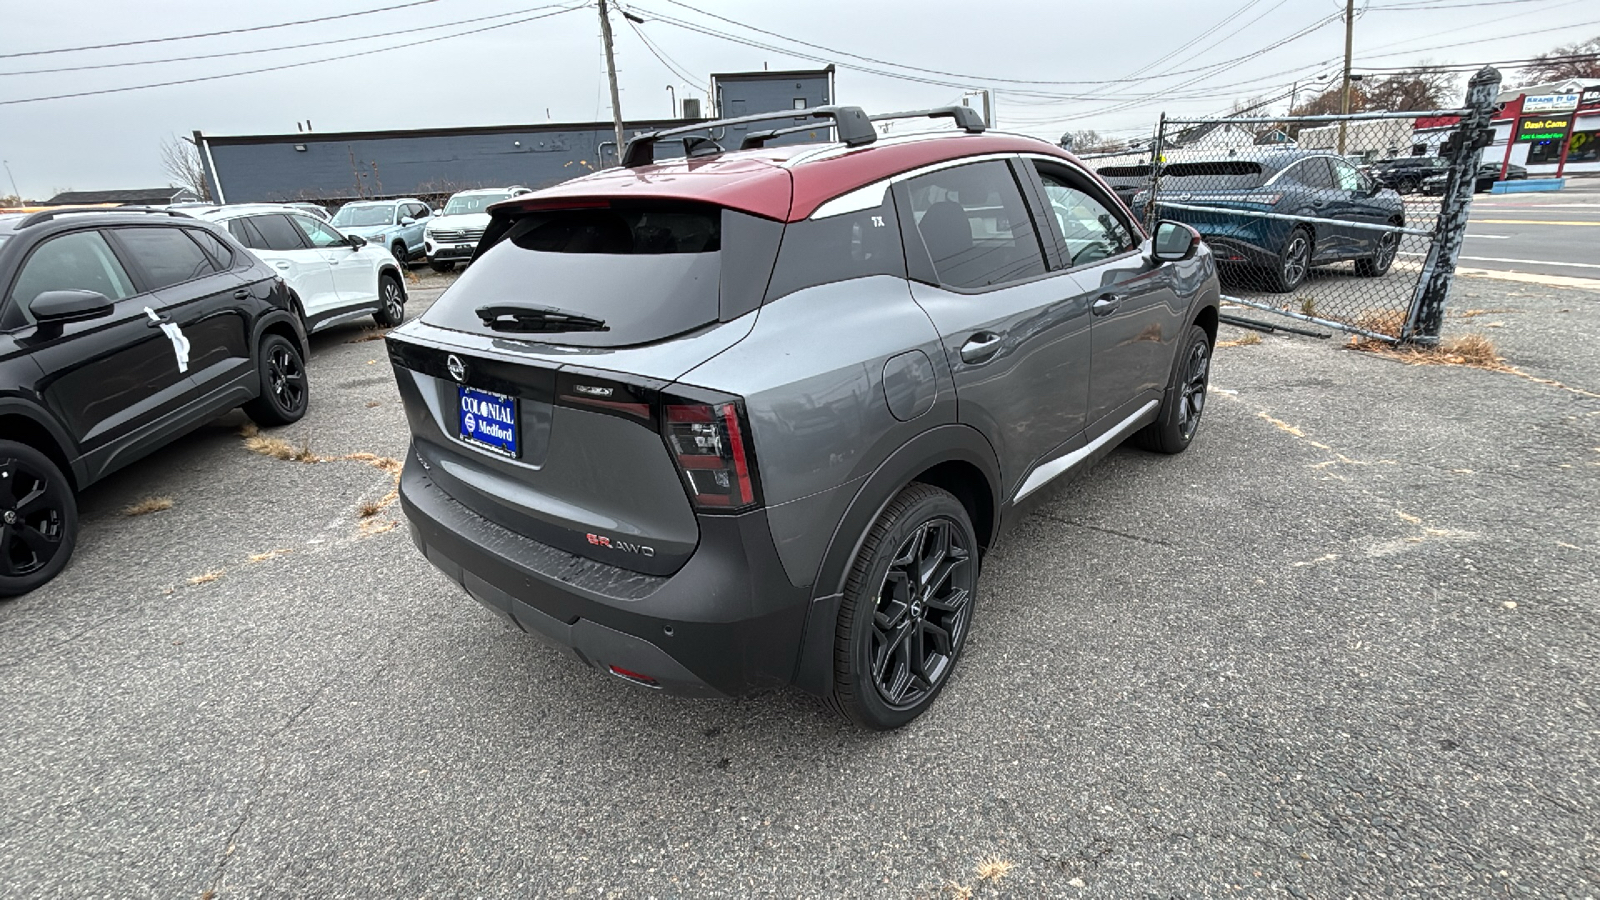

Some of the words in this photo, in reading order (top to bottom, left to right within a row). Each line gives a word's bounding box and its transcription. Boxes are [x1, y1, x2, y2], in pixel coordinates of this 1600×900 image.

[1524, 121, 1544, 129] Dash
[1545, 120, 1567, 128] Cams
[461, 396, 514, 425] COLONIAL
[478, 419, 513, 442] Medford
[615, 540, 655, 557] AWD
